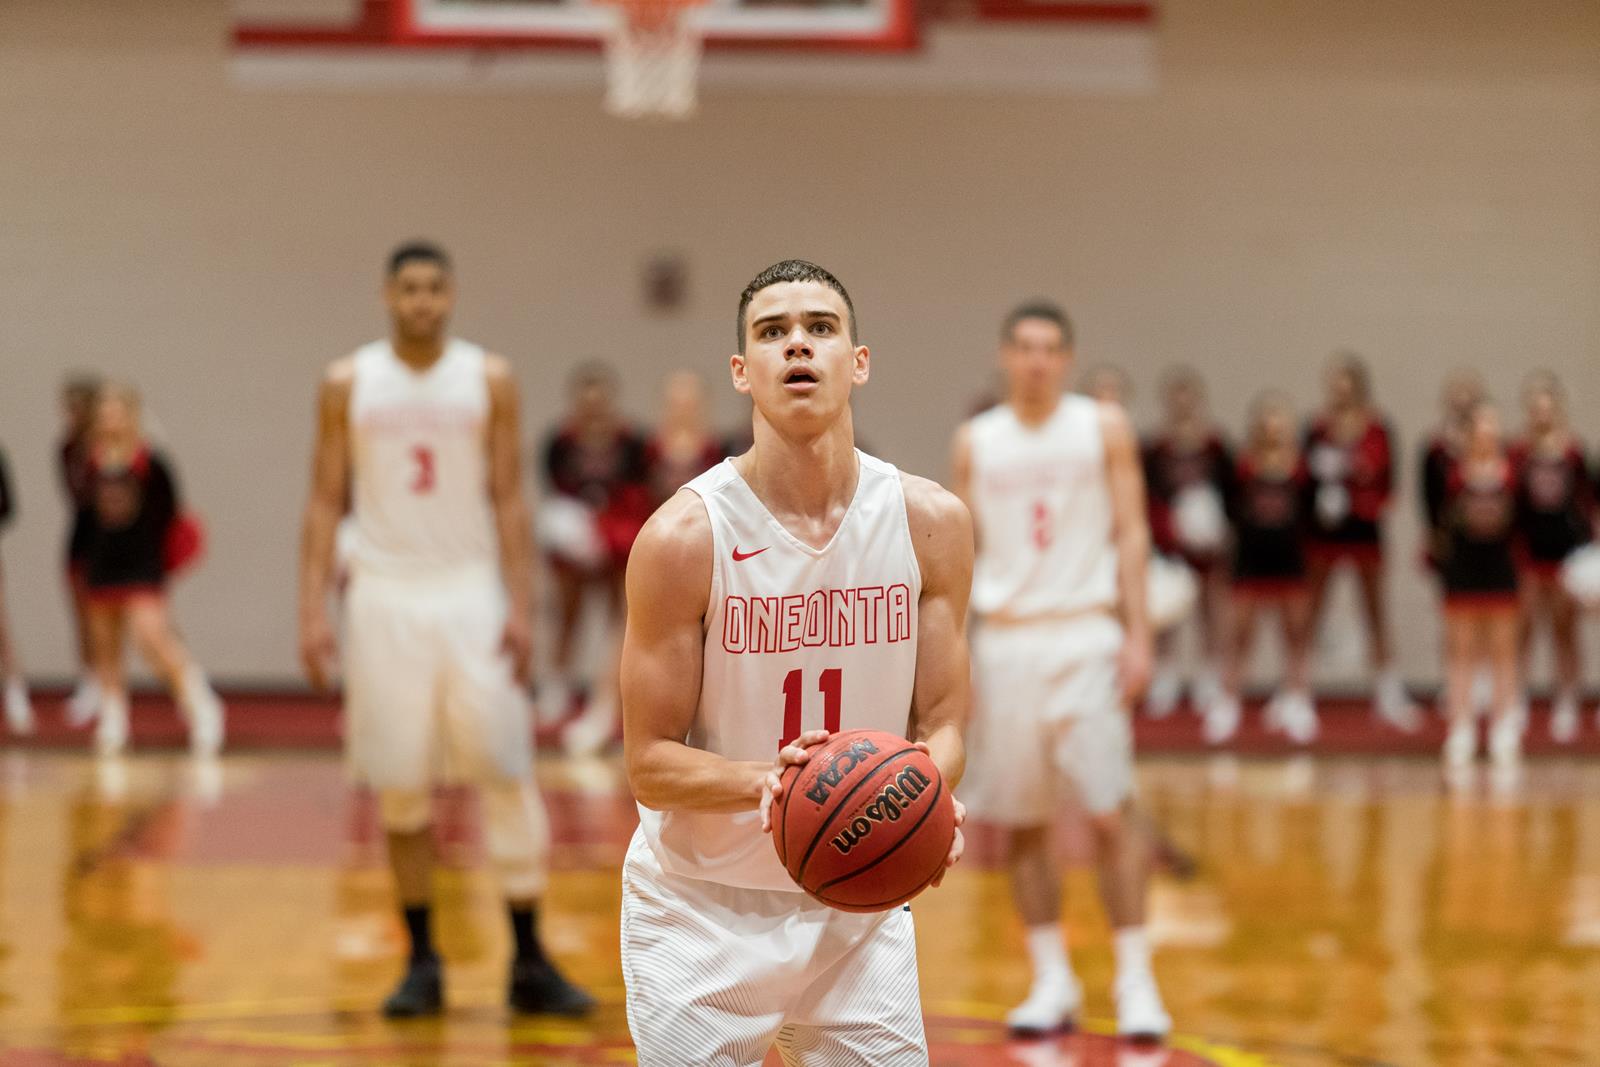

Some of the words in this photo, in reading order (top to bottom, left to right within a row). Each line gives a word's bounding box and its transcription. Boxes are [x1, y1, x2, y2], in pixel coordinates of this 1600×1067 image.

[722, 583, 910, 654] ONEONTA
[778, 668, 843, 754] 11
[805, 738, 879, 806] NCAA
[829, 764, 932, 856] Wilson
